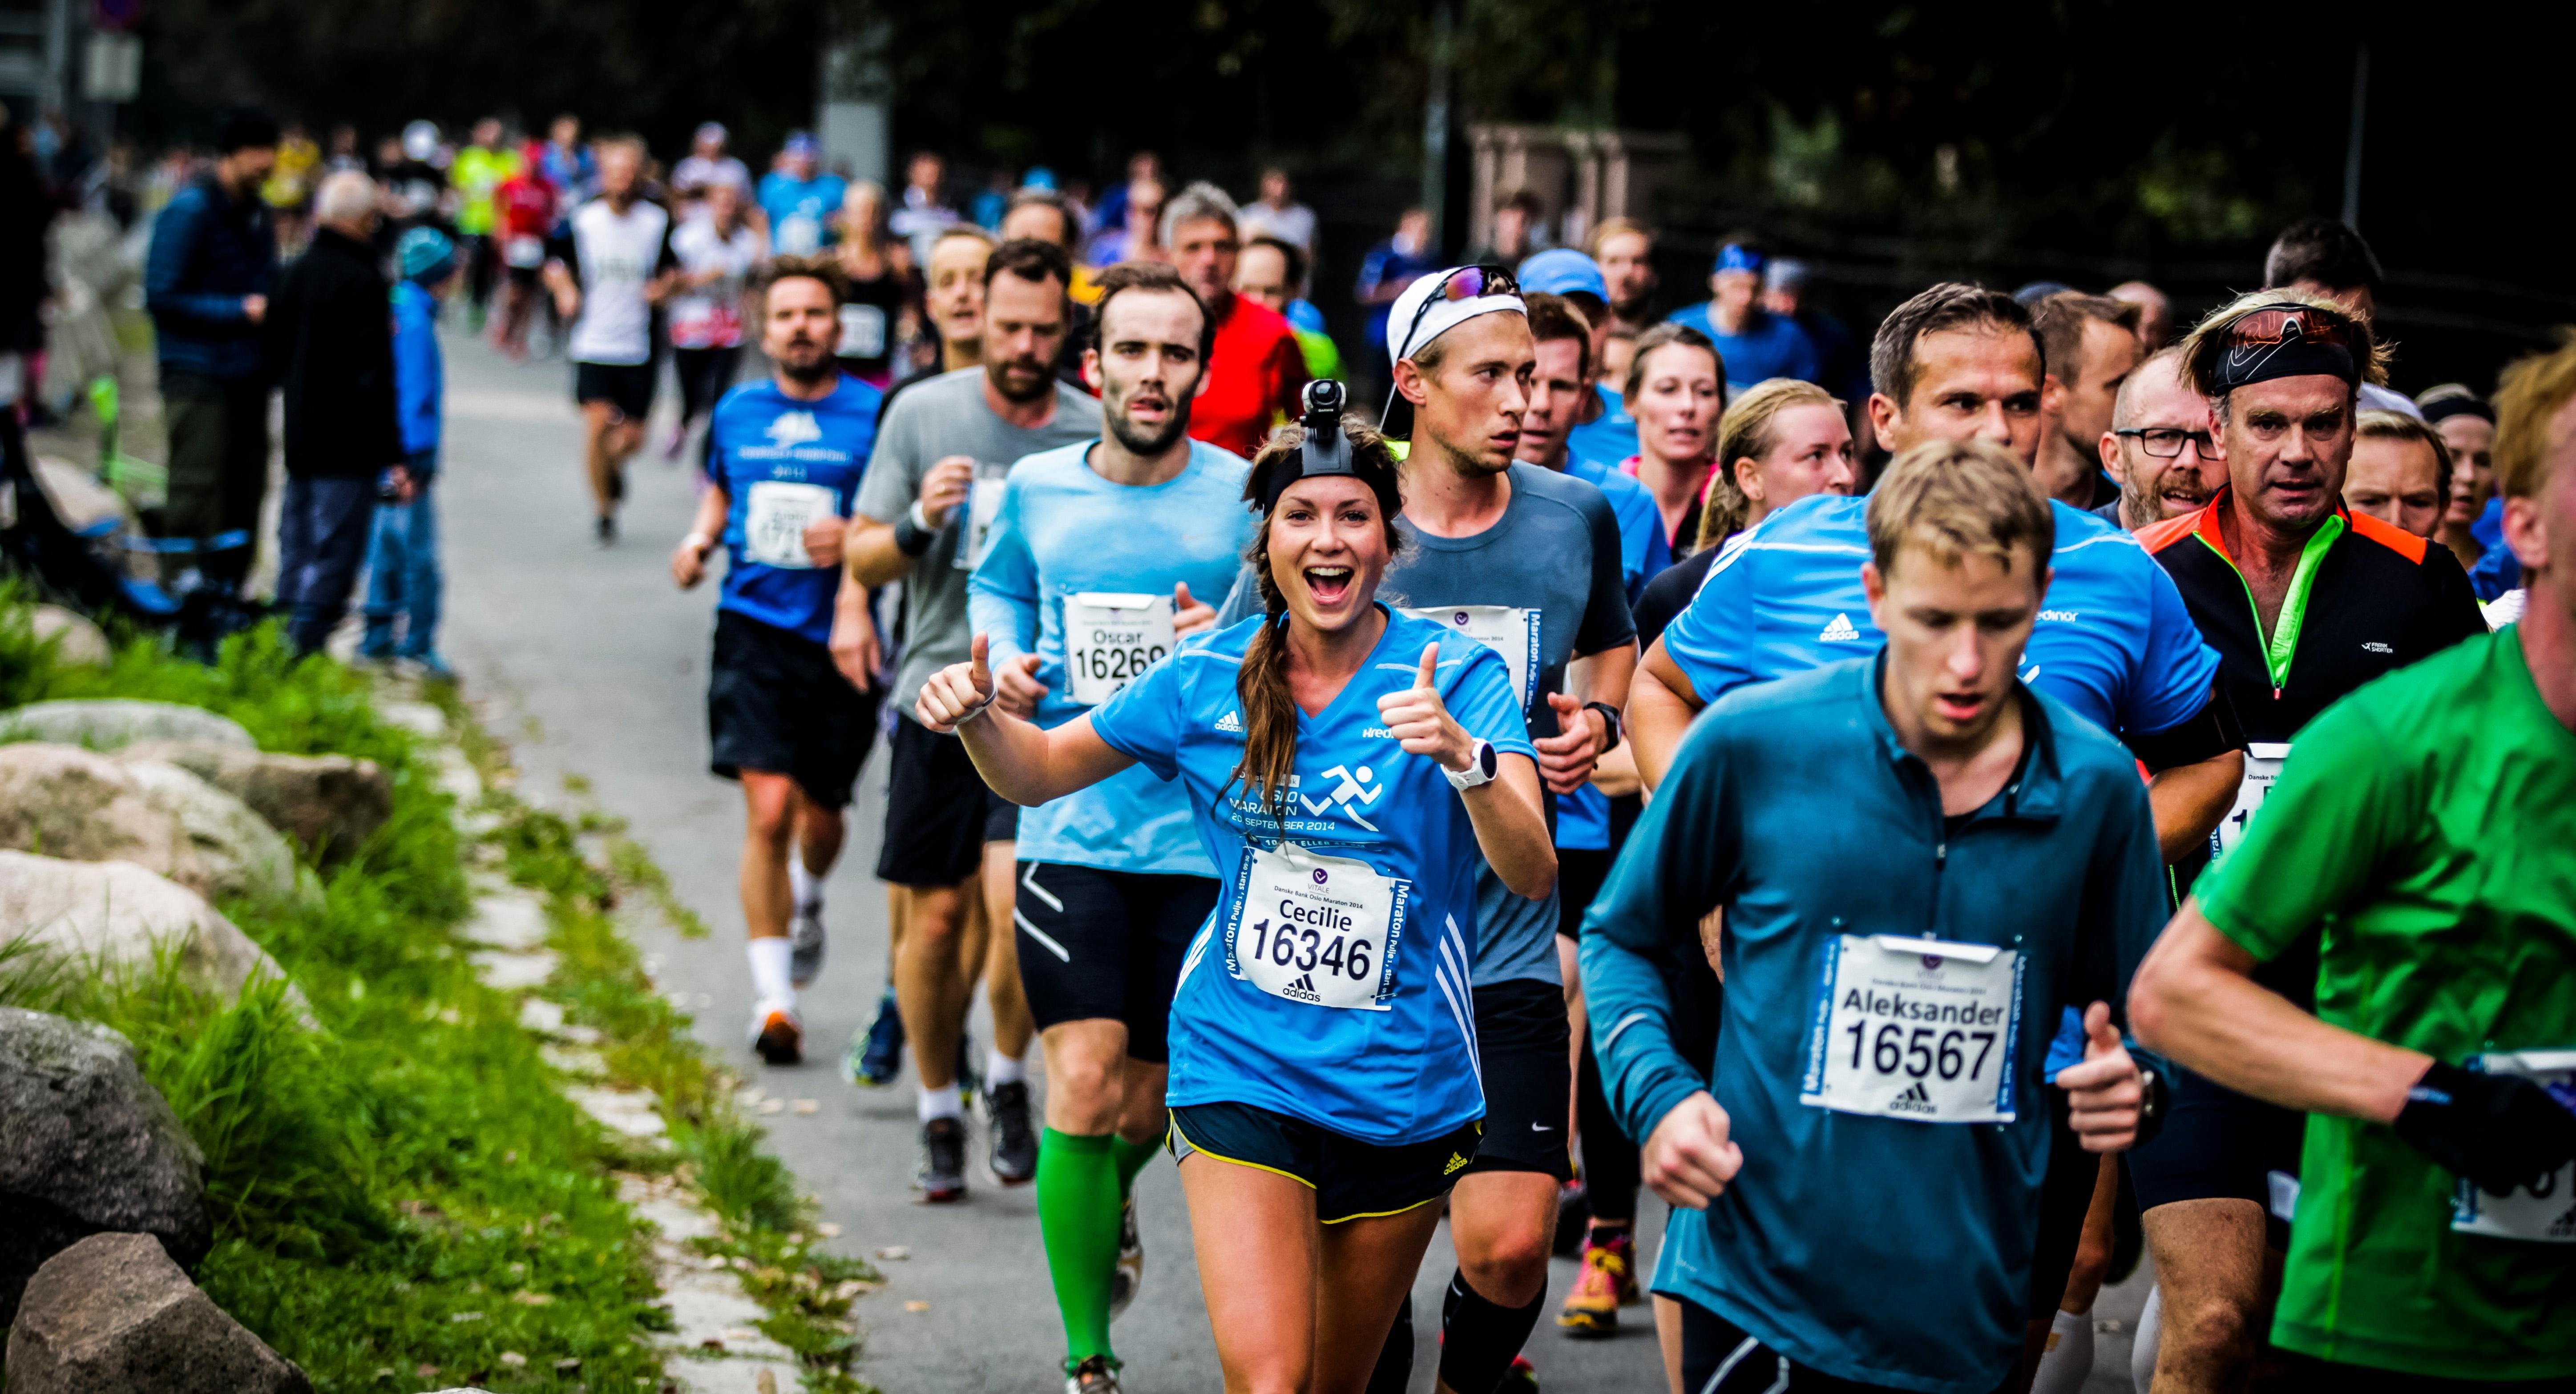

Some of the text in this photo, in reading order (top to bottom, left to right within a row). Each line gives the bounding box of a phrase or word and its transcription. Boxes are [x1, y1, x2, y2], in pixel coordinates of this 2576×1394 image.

[2036, 610, 2079, 622] edinor
[1093, 629, 1143, 645] Oscar
[1530, 613, 1540, 662] Maraton
[1819, 630, 1860, 641] adidas
[1306, 822, 1335, 831] 2014
[1274, 885, 1294, 895] Danske
[1323, 897, 1348, 906] Maraton
[1308, 883, 1330, 894] VITALE
[1225, 922, 1237, 971] Maraton
[1231, 900, 1242, 921] Pulje
[1239, 871, 1248, 890] start
[1280, 899, 1352, 932] Cecilie
[1391, 884, 1410, 939] Maraton
[1253, 918, 1372, 981] 16346
[1387, 939, 1397, 959] Pulje
[1384, 968, 1392, 986] start
[1282, 987, 1321, 1002] adidas
[1843, 988, 2005, 1026] Aleksander
[1846, 1019, 1997, 1081] 16567
[1889, 1100, 1937, 1114] adidas
[1443, 1158, 1468, 1175] adidas
